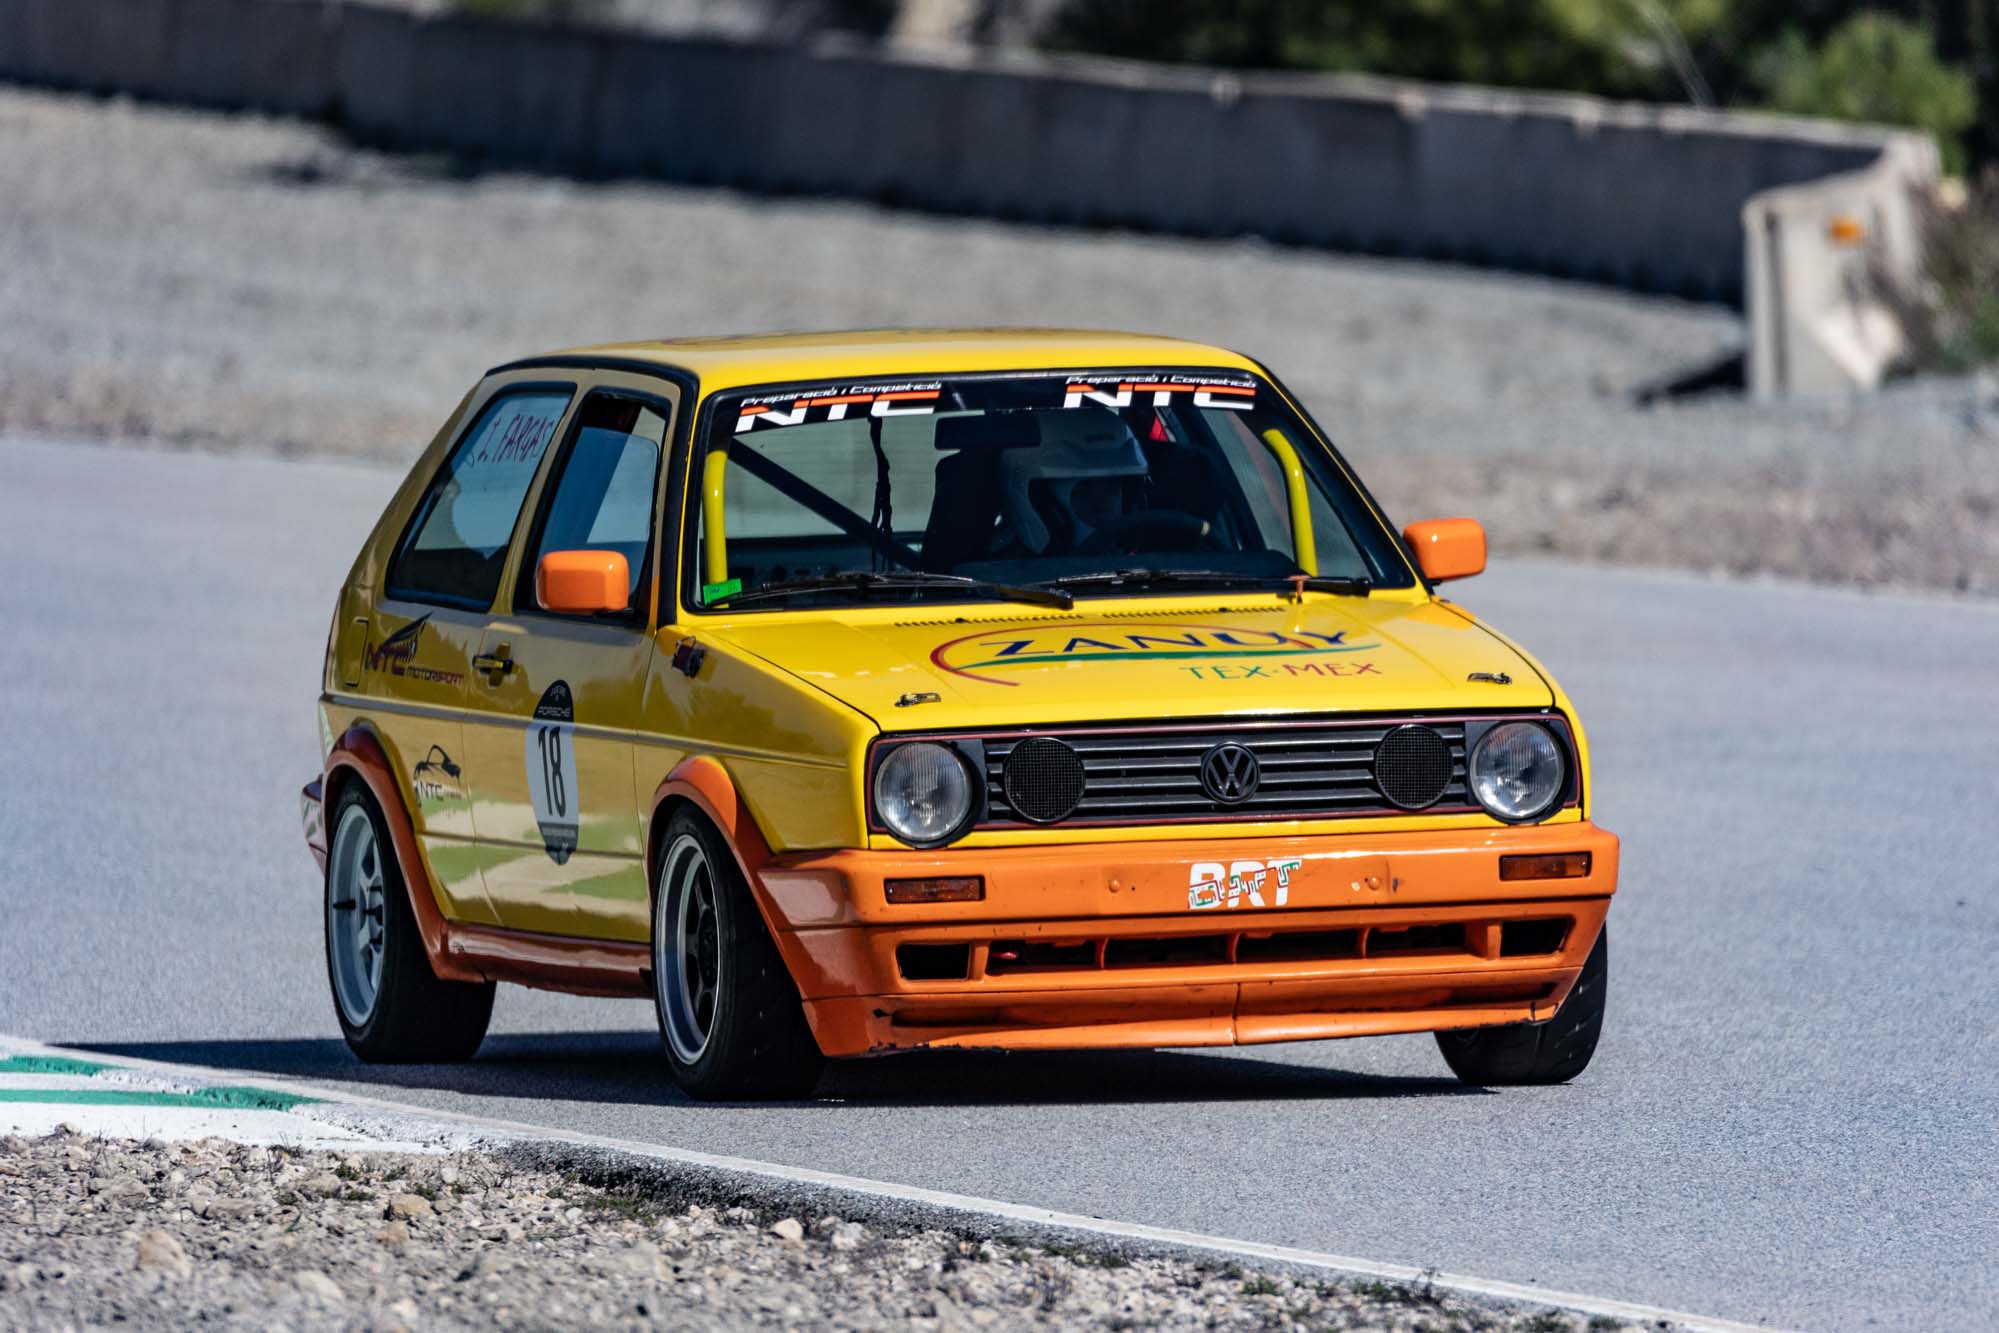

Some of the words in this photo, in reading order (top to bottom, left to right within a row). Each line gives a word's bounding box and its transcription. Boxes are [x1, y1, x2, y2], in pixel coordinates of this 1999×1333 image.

[734, 390, 940, 433] NTC
[1064, 384, 1257, 410] NTC
[979, 631, 1346, 657] ZANUY
[537, 725, 567, 818] 18
